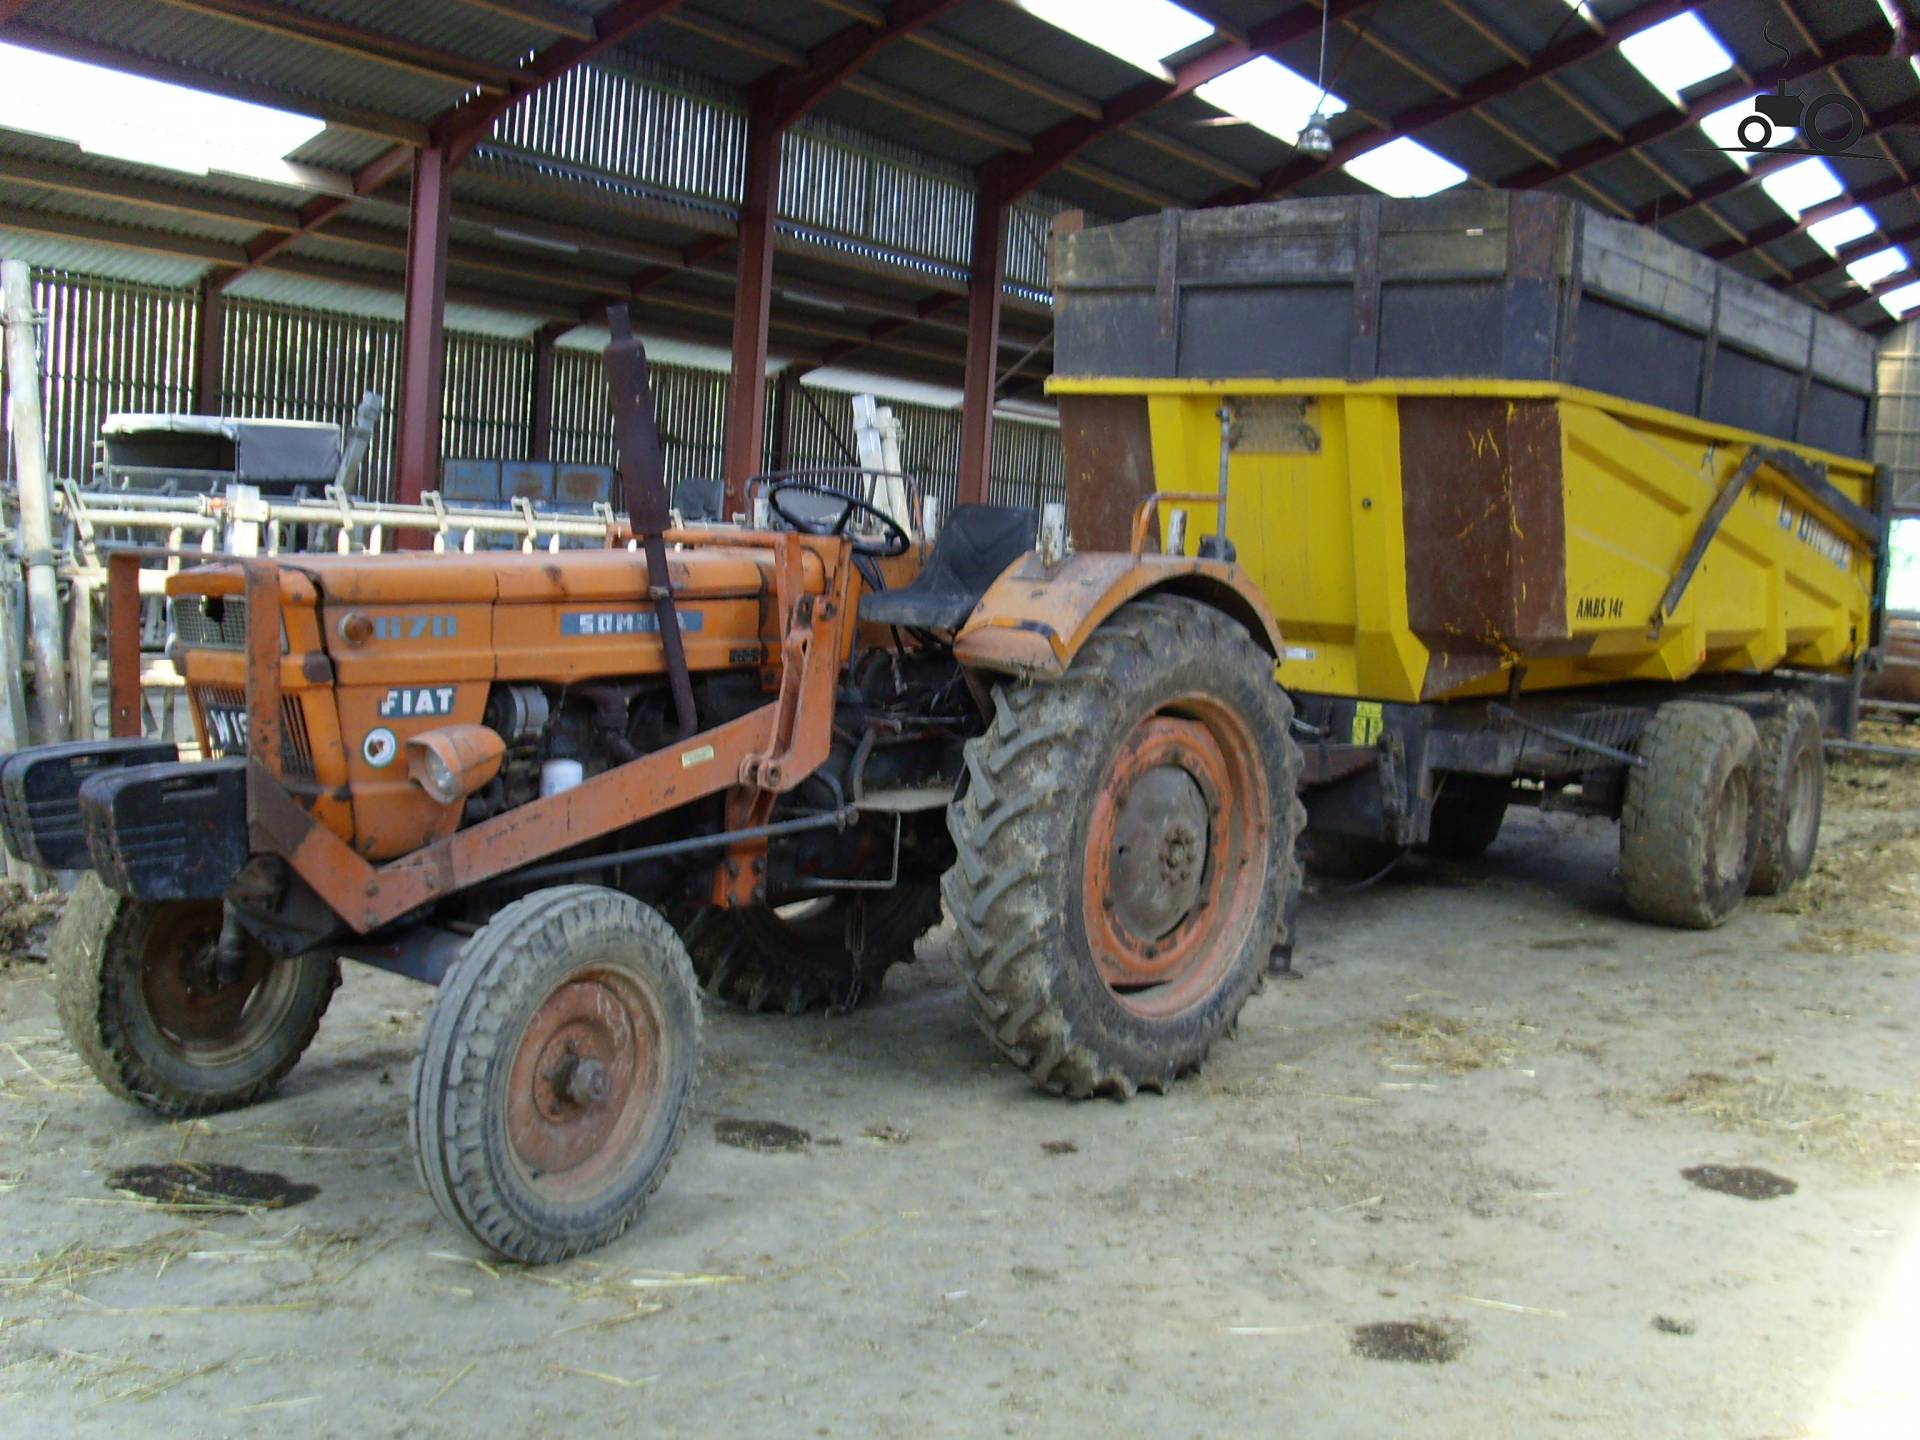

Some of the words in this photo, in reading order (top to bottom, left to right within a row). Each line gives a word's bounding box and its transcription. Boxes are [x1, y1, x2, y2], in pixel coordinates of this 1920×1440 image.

[579, 608, 687, 634] SOMA
[1576, 597, 1606, 619] AMBS
[381, 687, 453, 715] FIAT
